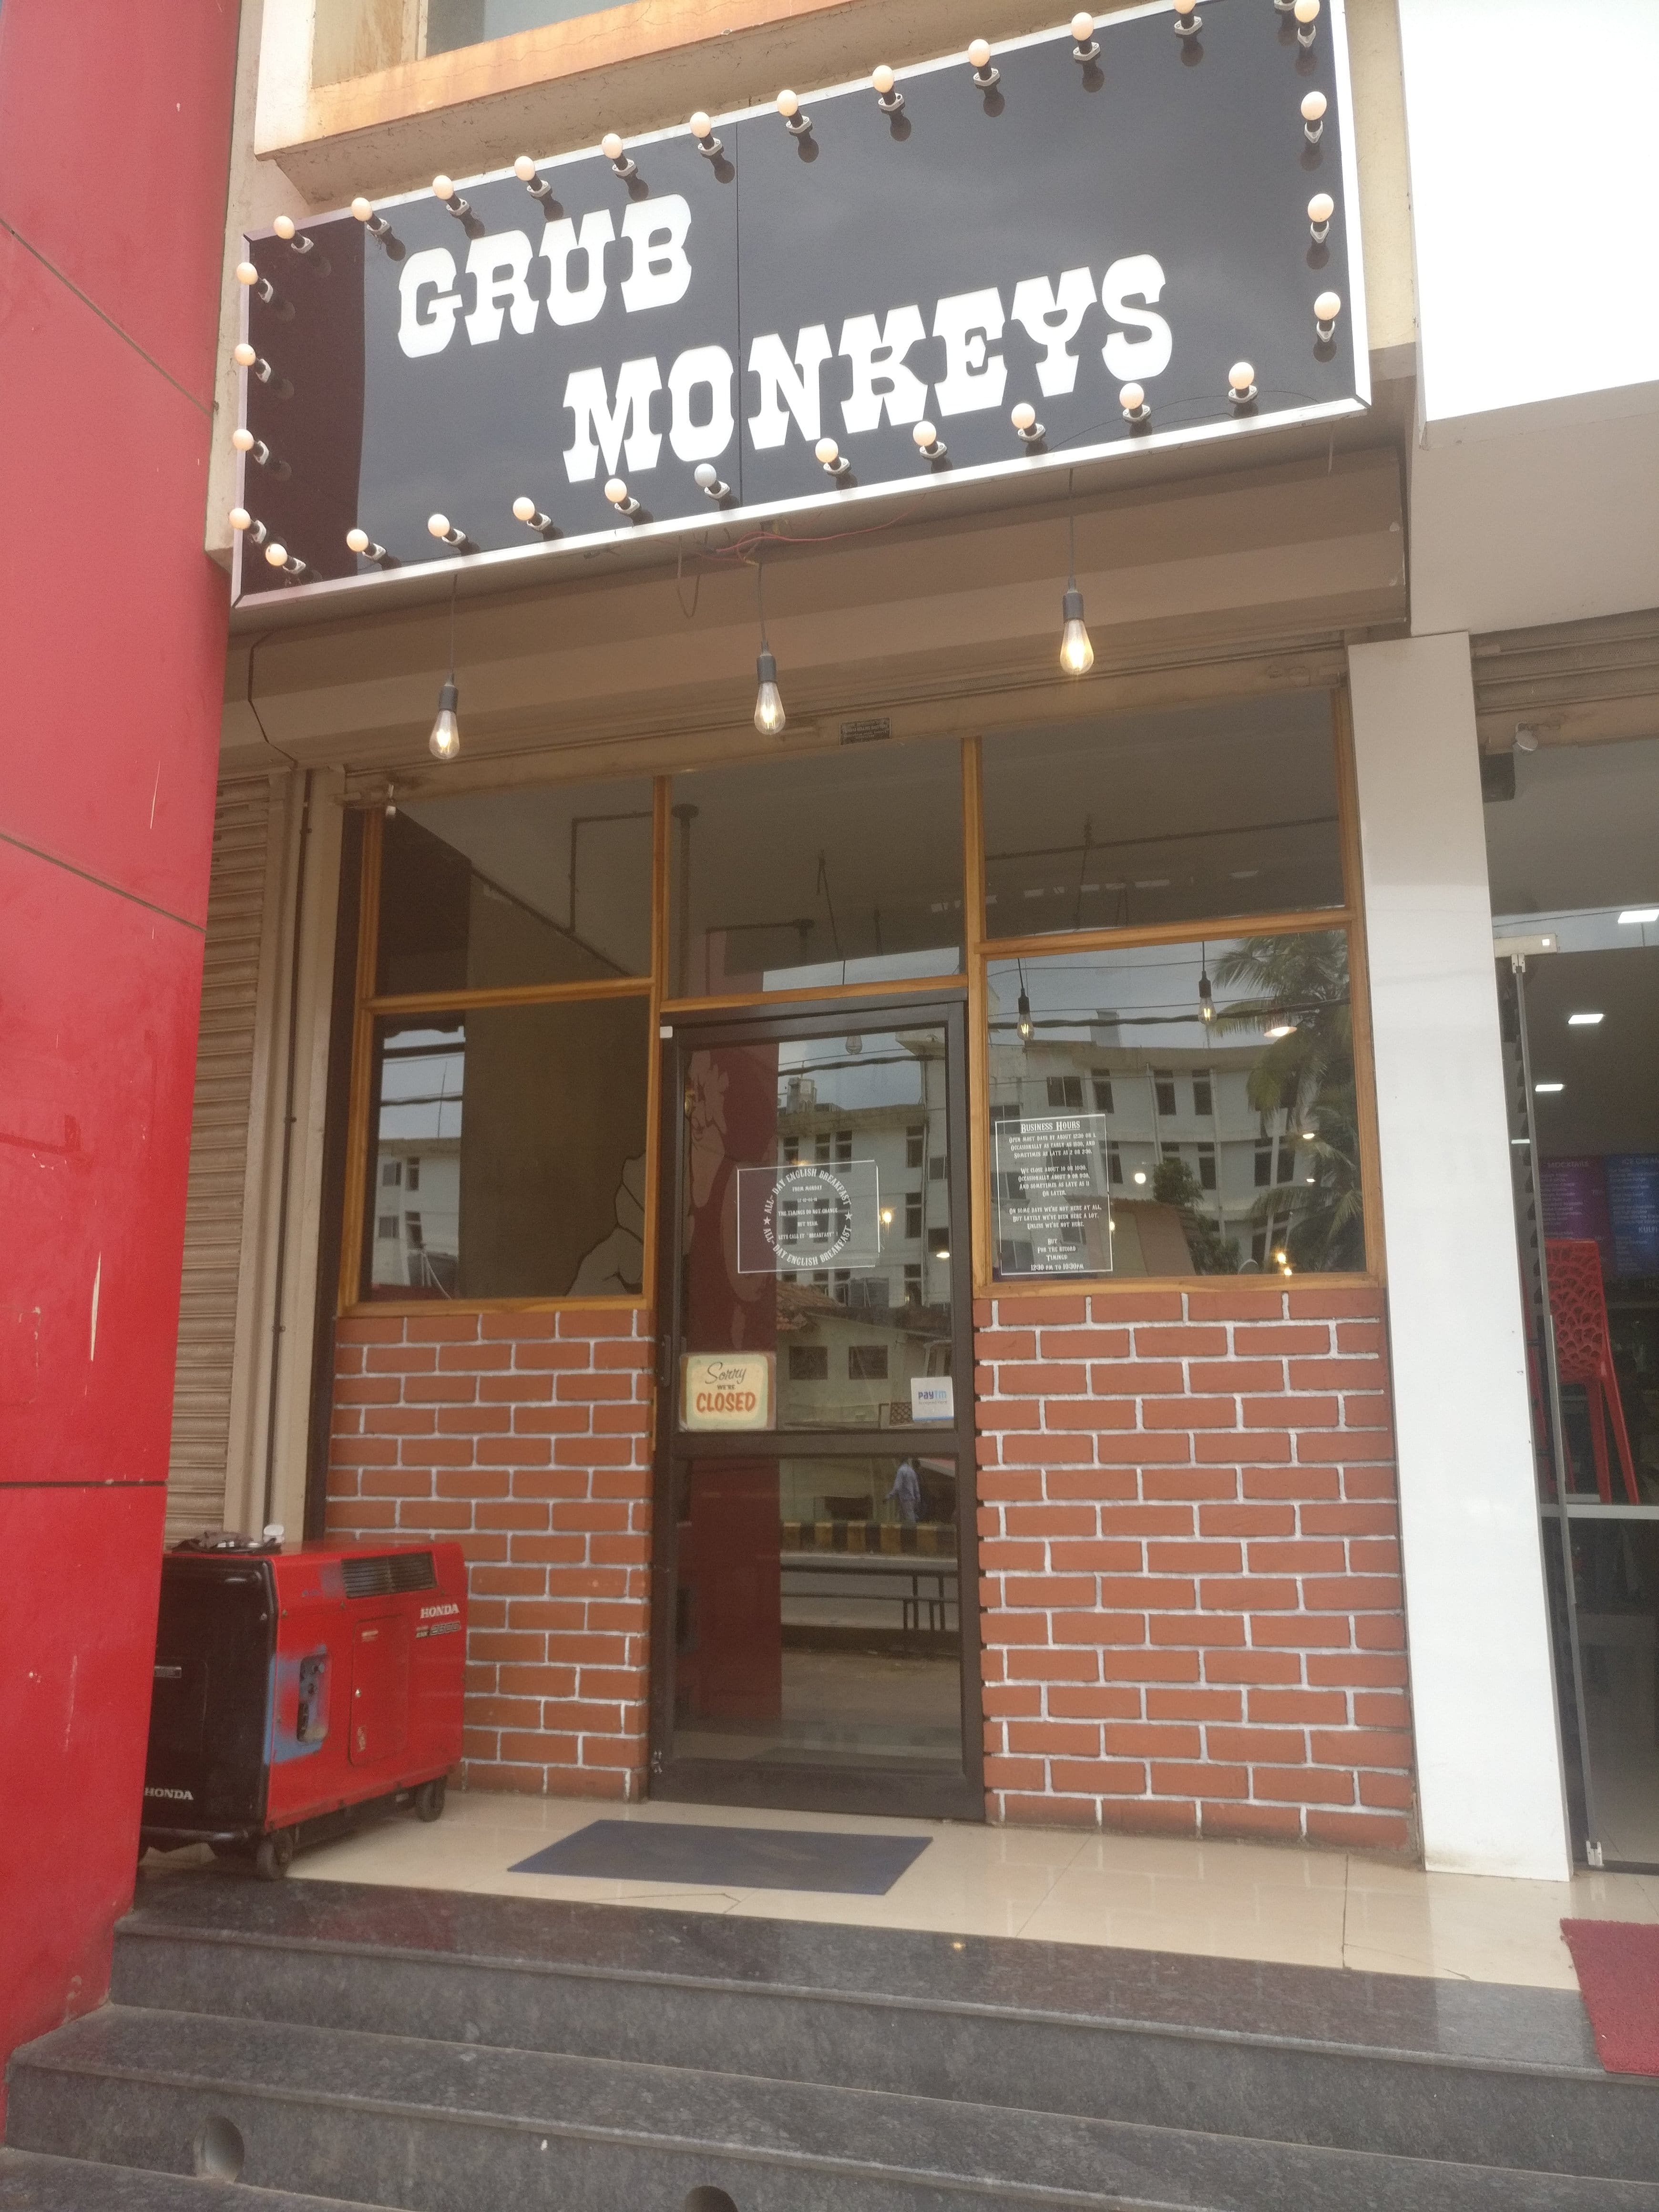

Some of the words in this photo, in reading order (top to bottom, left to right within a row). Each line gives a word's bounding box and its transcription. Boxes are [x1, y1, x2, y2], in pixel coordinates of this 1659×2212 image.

[398, 194, 692, 358] GRUB
[563, 254, 1173, 483] MONKEYS
[1020, 1123, 1053, 1133] BUSINESS
[1056, 1121, 1080, 1131] HOURS
[772, 1178, 786, 1195] DAY
[786, 1168, 817, 1183] ENGLISH
[819, 1170, 852, 1205] BREAKFAST
[772, 1244, 788, 1259] DAY
[787, 1253, 819, 1266] ENGLISH
[819, 1225, 852, 1263] BREAKFAST
[705, 1362, 747, 1384] Sorry
[696, 1391, 756, 1413] CLOSED
[420, 1604, 460, 1619] HONDA
[144, 1787, 194, 1801] HONDA
